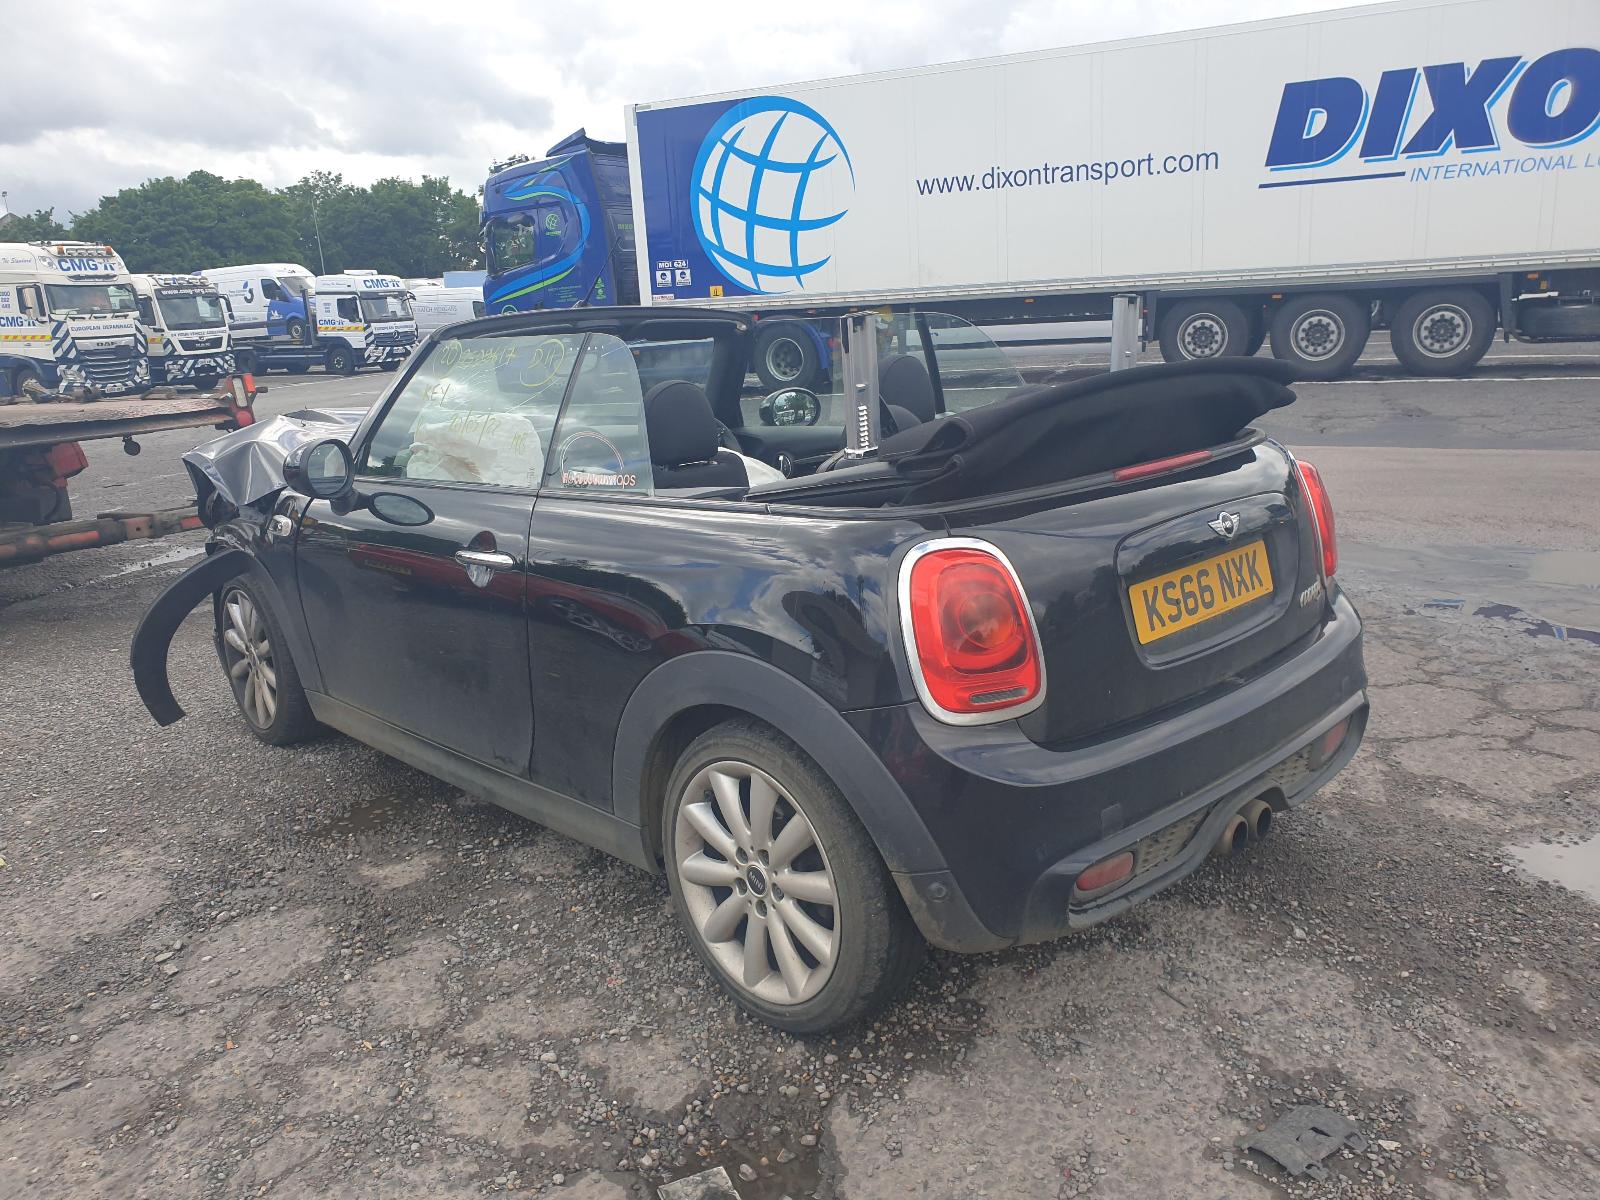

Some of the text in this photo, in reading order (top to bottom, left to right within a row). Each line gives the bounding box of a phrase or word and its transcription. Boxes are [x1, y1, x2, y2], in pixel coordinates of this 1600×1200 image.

[1264, 47, 1600, 172] DIXO
[916, 151, 1219, 196] www.dixontransport.com
[1409, 152, 1600, 183] INTERNATIONAL L
[57, 258, 98, 271] CMG
[363, 279, 389, 288] CMG
[0, 316, 24, 328] CMG
[1143, 549, 1264, 632] KS66 NXK
[748, 871, 764, 890] MINI
